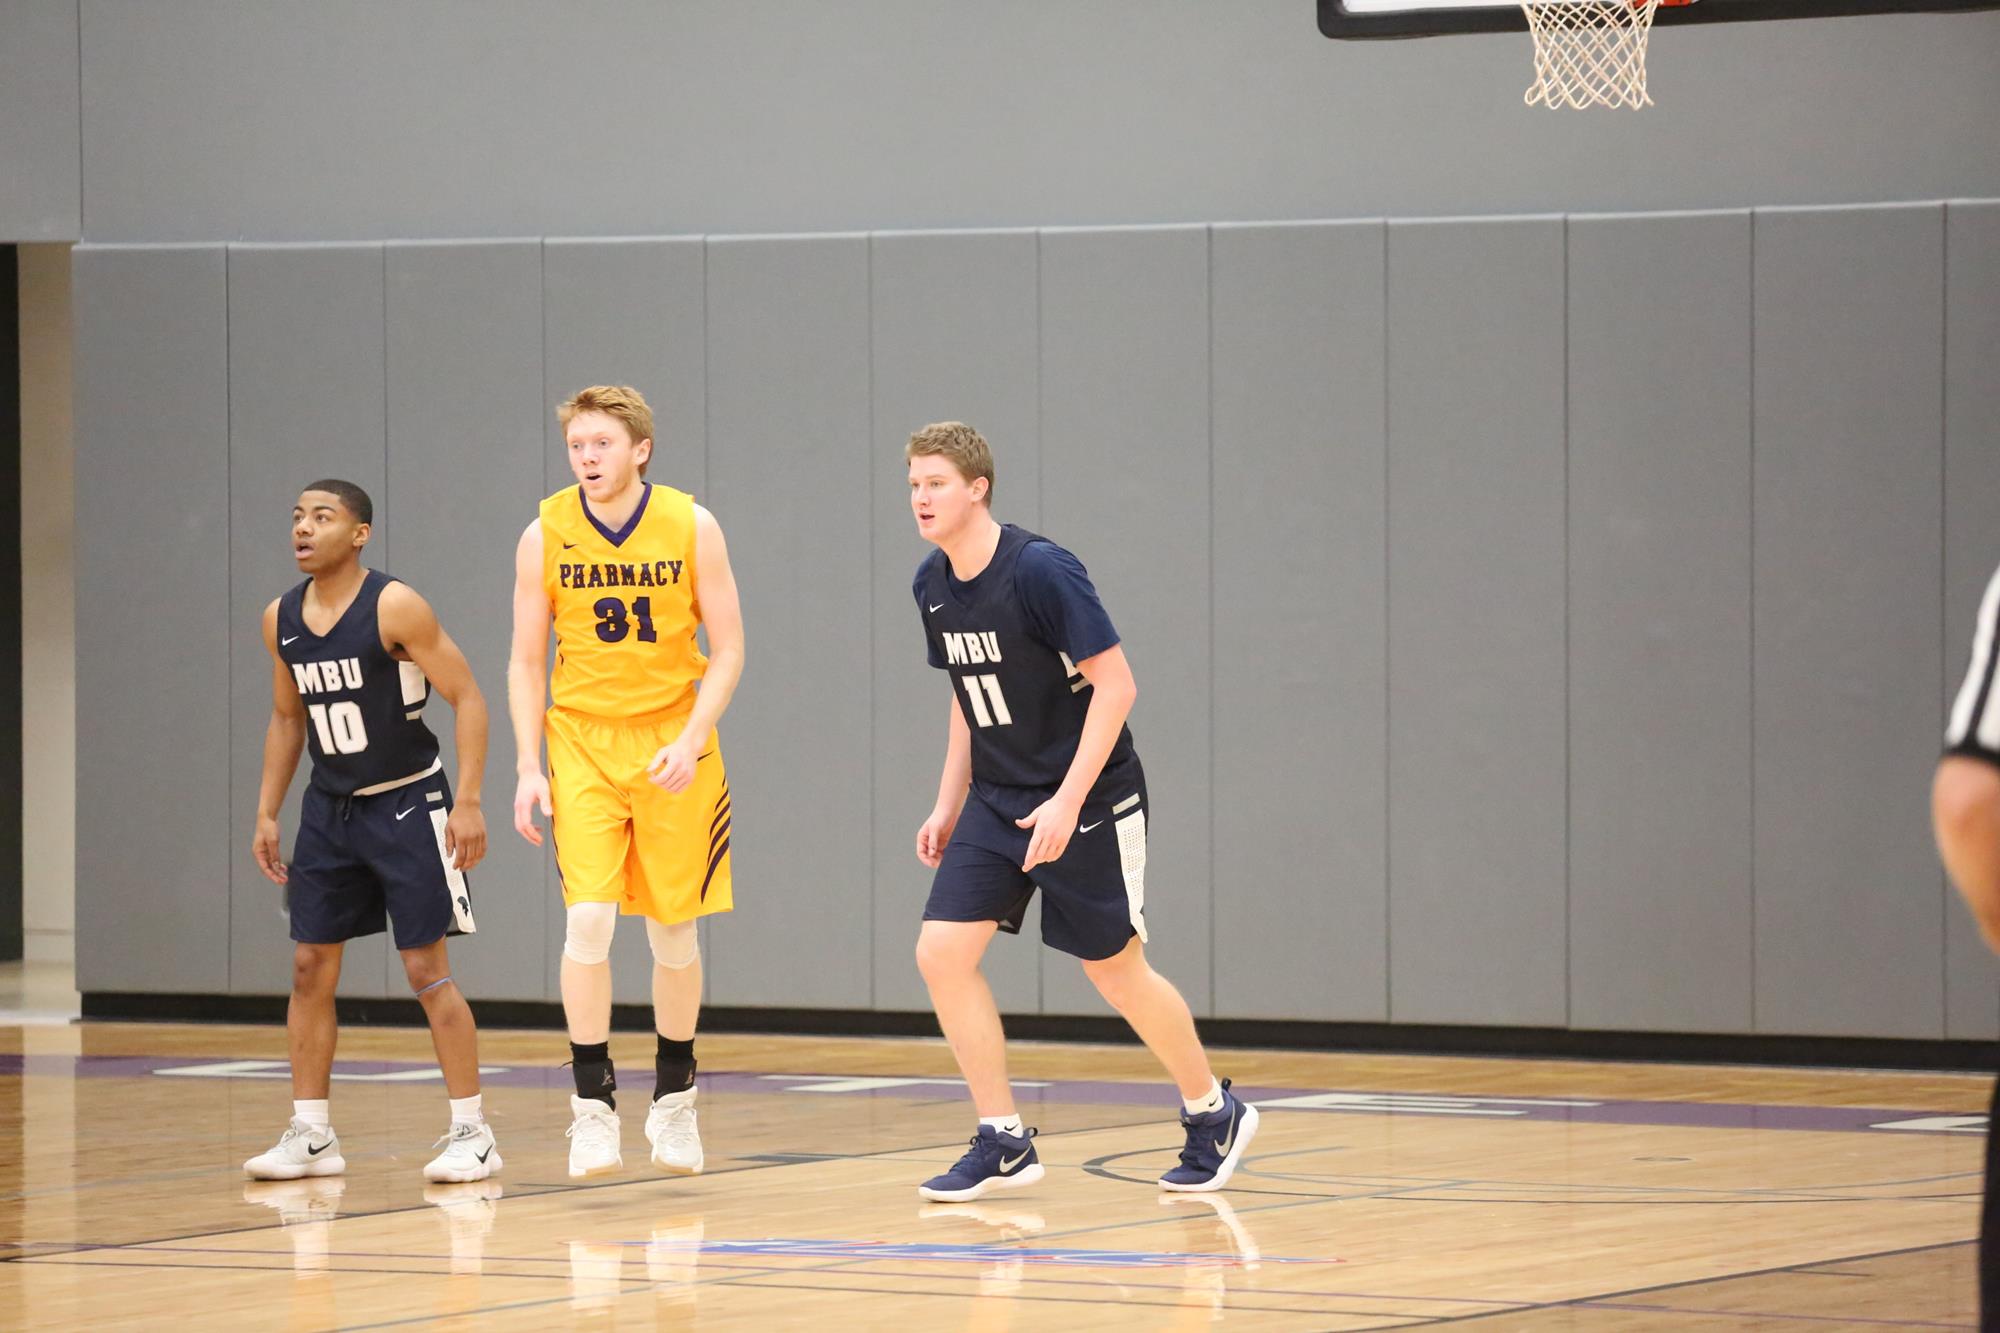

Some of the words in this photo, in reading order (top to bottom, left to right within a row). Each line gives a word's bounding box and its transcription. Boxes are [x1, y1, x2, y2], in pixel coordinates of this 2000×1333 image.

[559, 560, 683, 589] PHARMACY
[593, 596, 657, 643] 31
[942, 631, 1002, 666] MBU
[292, 657, 364, 695] MBU
[961, 673, 1013, 728] 11
[308, 700, 369, 755] 10
